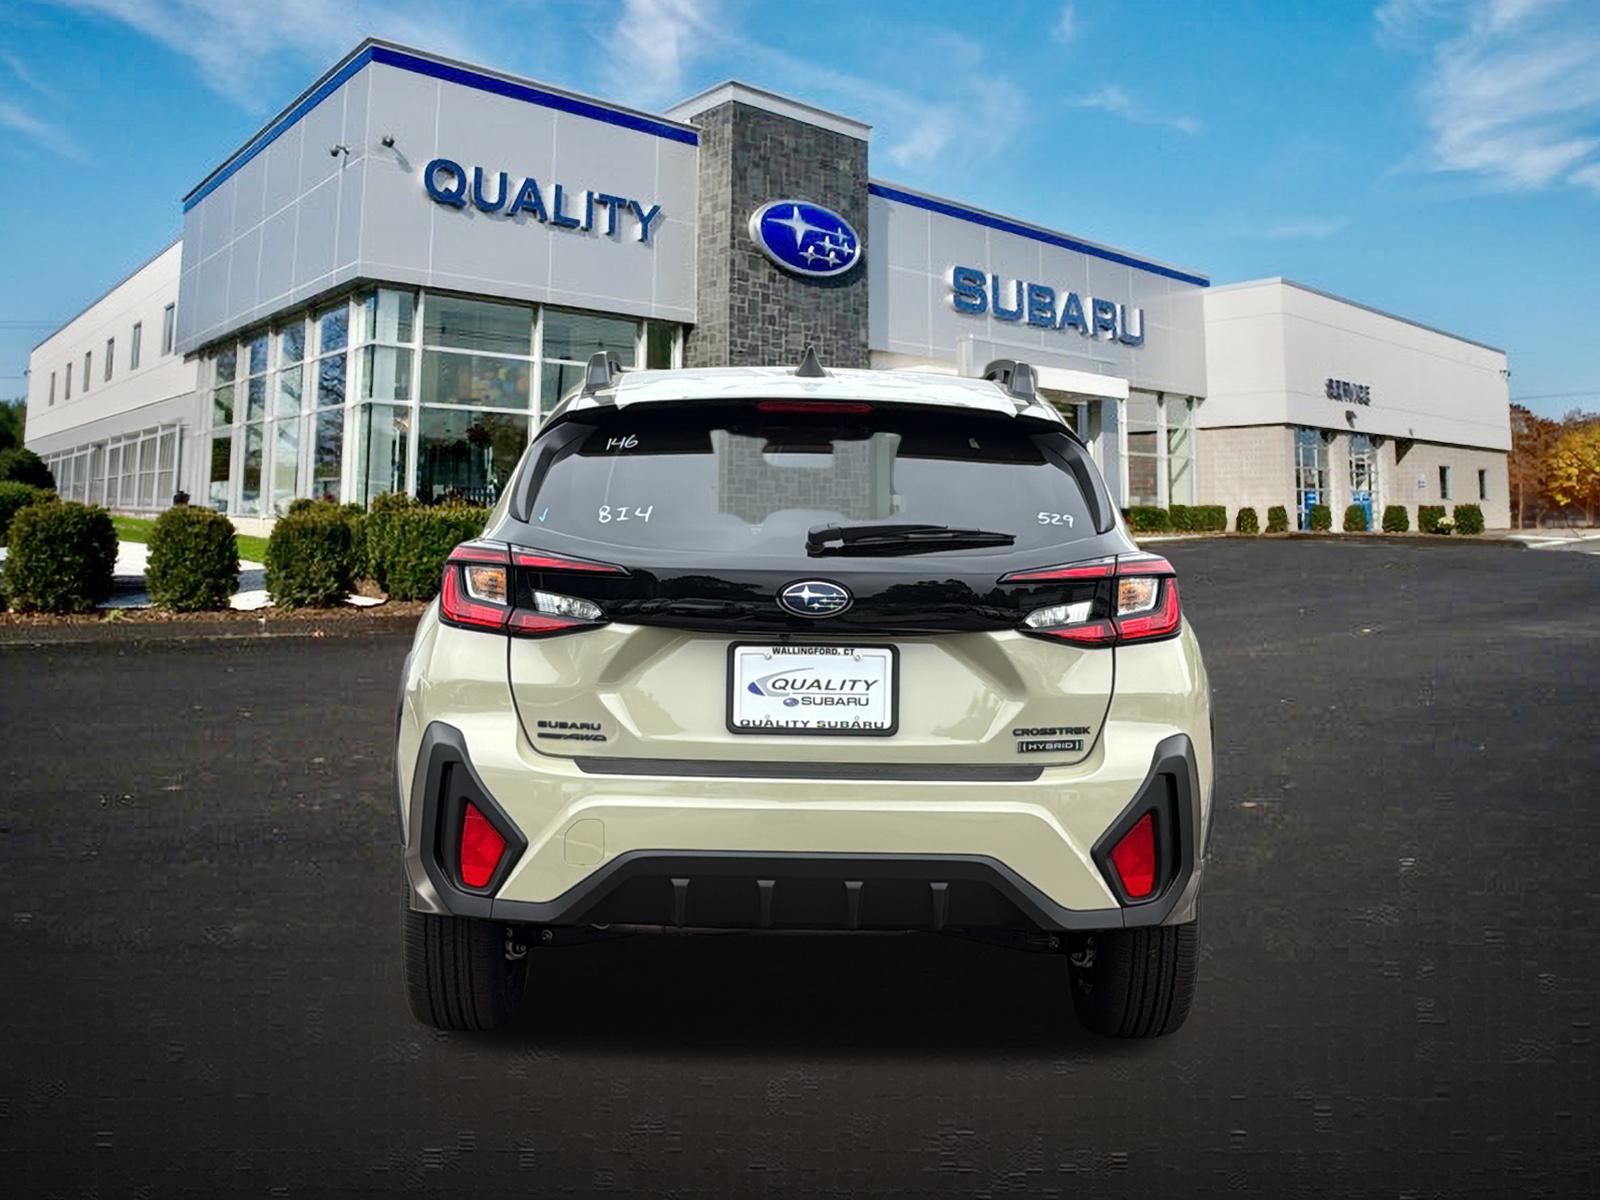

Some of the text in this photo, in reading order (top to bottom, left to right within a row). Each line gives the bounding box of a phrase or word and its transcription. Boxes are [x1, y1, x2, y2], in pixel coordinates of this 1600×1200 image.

[424, 158, 662, 243] QUALITY
[952, 265, 1145, 346] SUBARU
[606, 434, 639, 451] 146
[1037, 512, 1074, 528] 529
[843, 648, 855, 656] CT
[771, 678, 879, 691] QUALITY
[801, 697, 869, 706] SUBARU
[537, 720, 601, 730] SUBARU
[740, 719, 884, 729] QUALITY SUBARU
[1012, 726, 1091, 736] CROSSTREK
[1028, 742, 1074, 750] HYBRID
